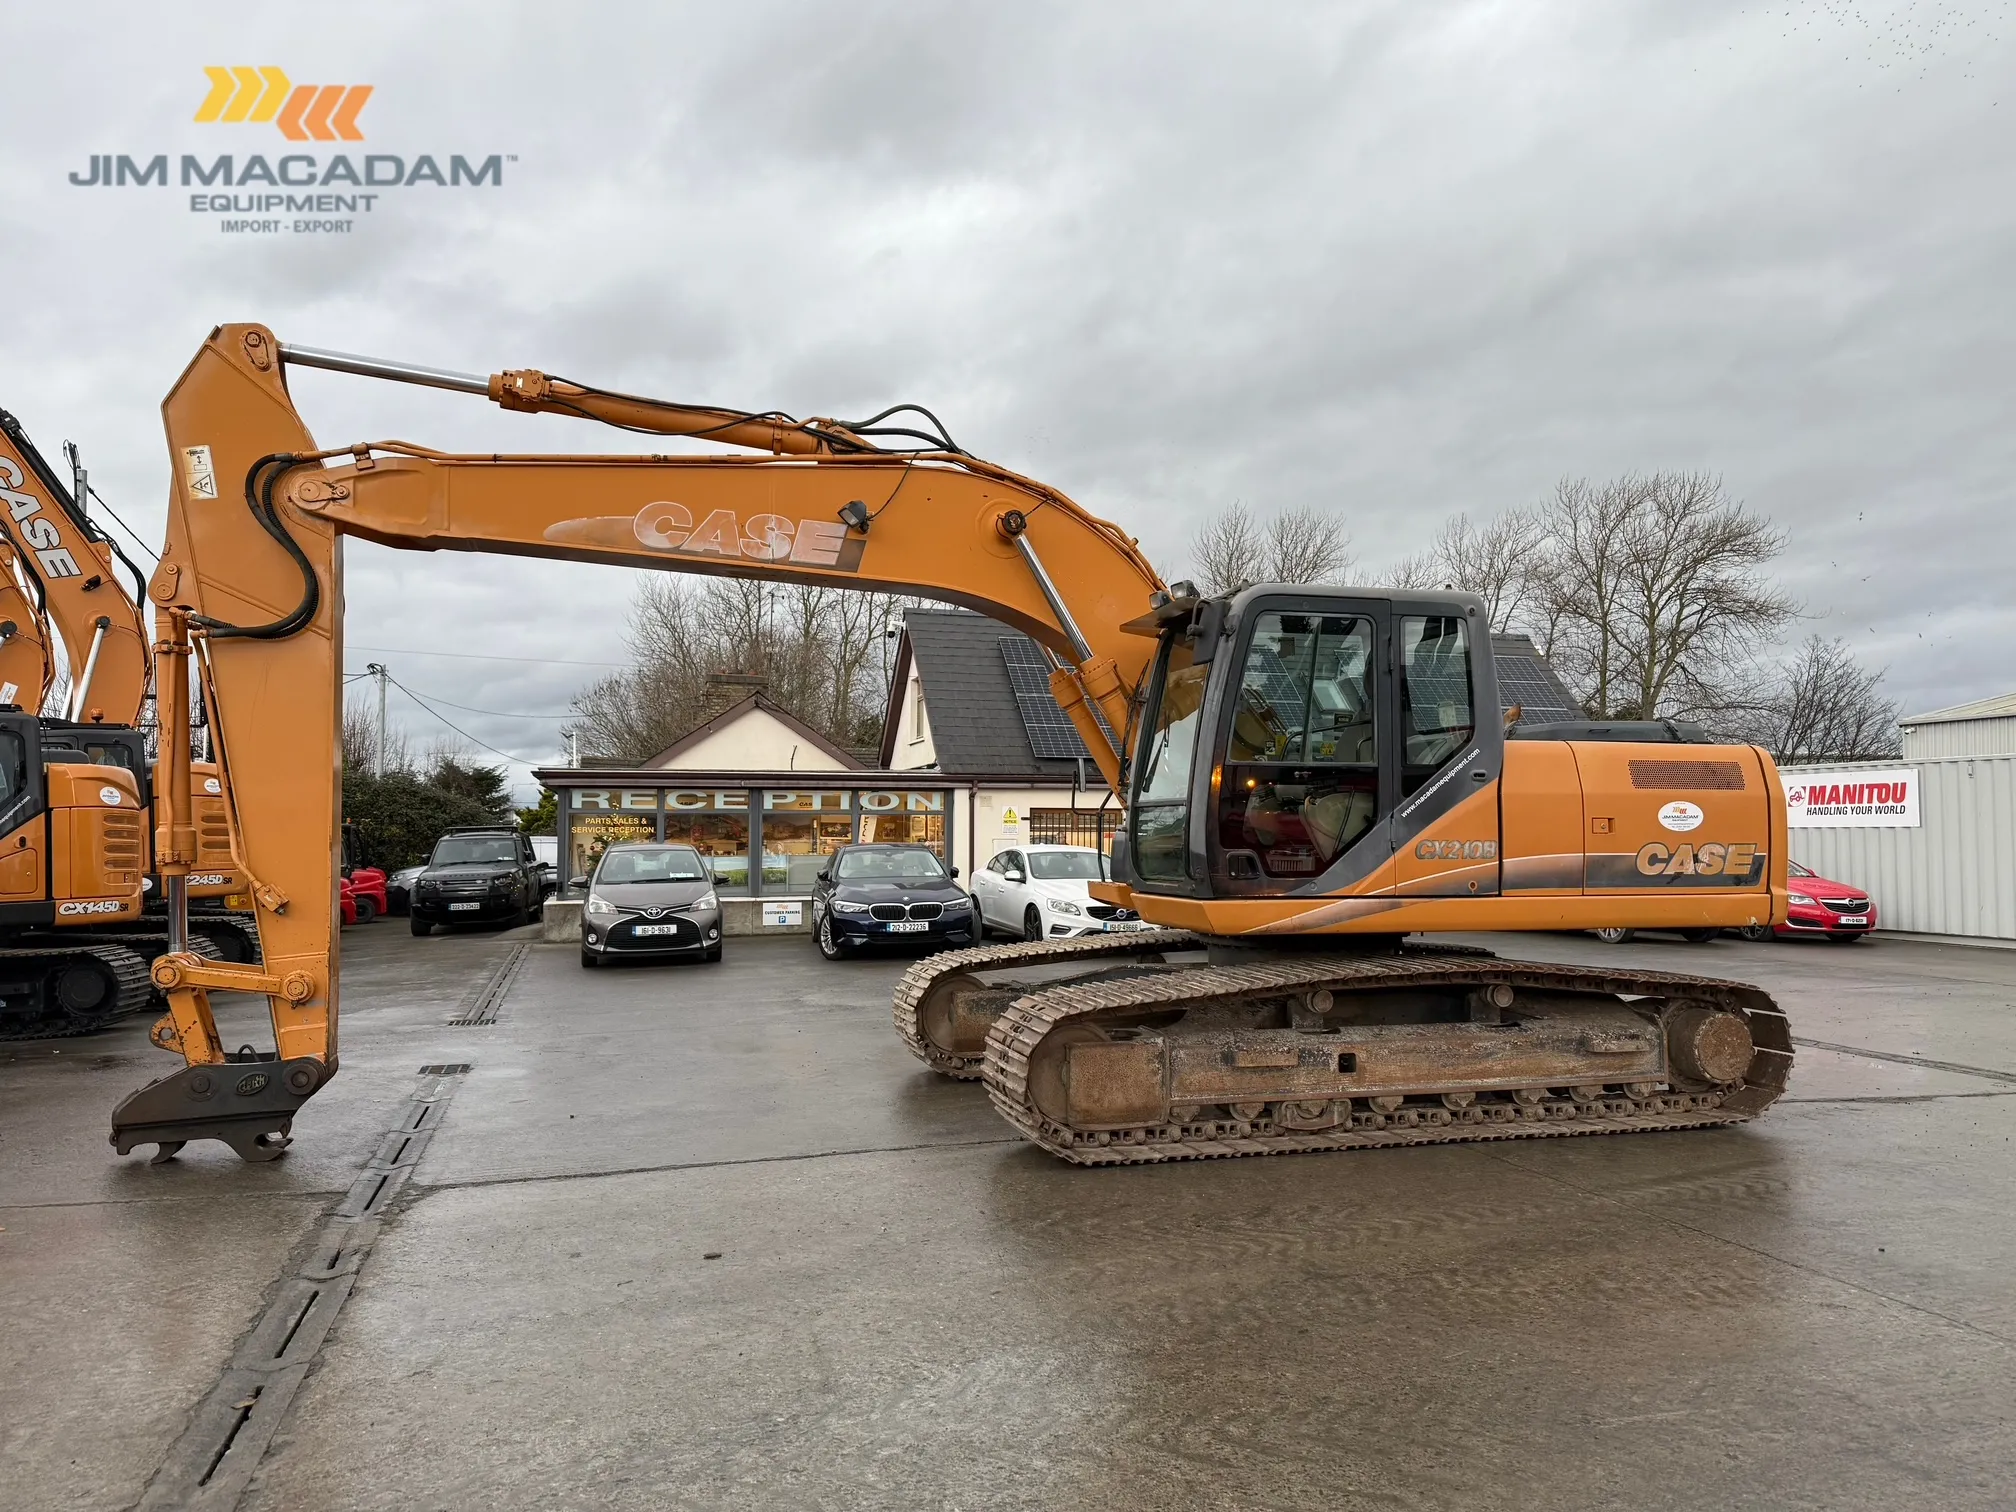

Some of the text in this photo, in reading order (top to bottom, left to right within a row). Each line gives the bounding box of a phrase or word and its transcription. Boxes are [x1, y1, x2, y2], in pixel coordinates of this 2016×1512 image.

[0, 454, 83, 579] CASE
[633, 501, 849, 566] CASE
[1401, 748, 1480, 818] www.macadamequipment.com
[1807, 782, 1907, 805] MANITOU
[571, 789, 941, 811] RECEPTION
[1806, 805, 1906, 816] HANDLING YOUR WORLD
[1415, 839, 1498, 860] CX210B
[1635, 841, 1758, 876] CASE
[223, 877, 233, 885] SR
[58, 900, 129, 916] CX145D SR
